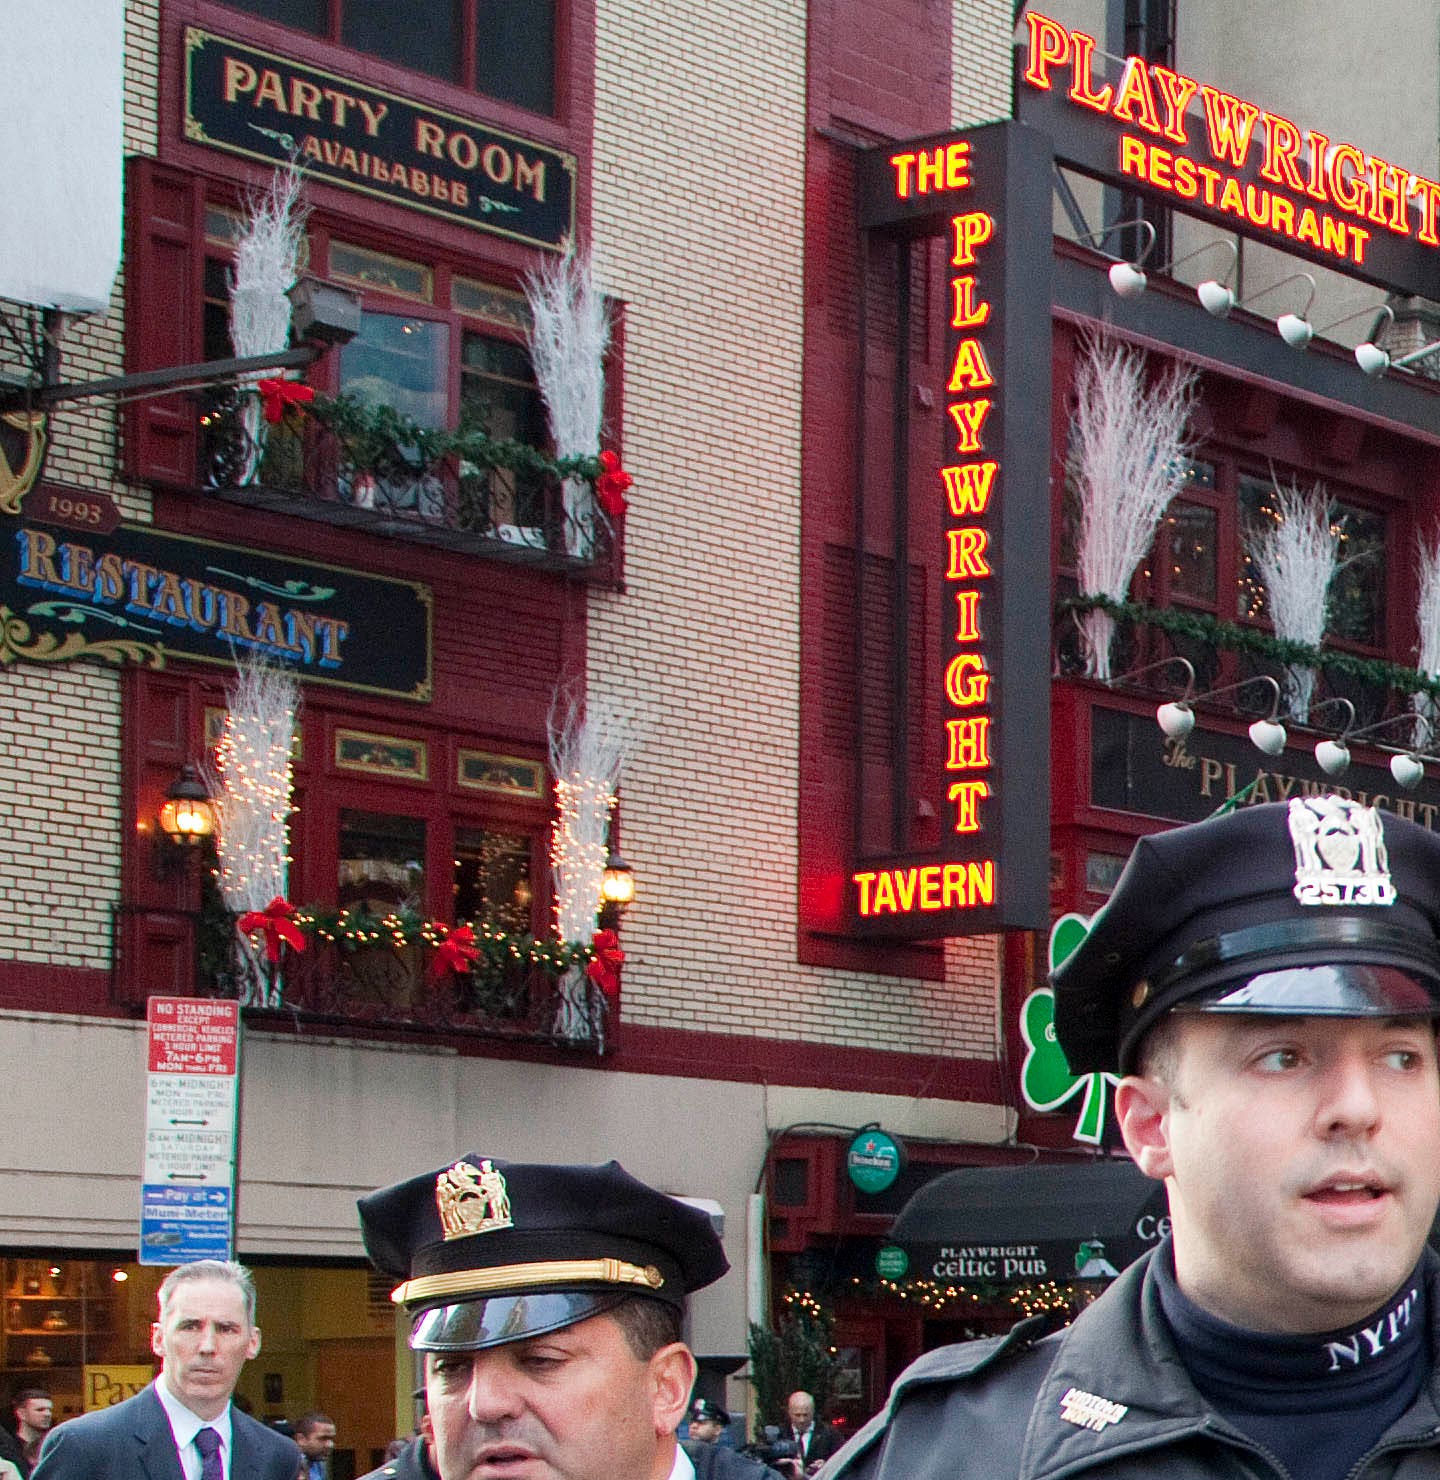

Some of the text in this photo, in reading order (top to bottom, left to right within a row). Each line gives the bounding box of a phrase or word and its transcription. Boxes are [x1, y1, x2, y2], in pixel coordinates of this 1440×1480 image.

[223, 57, 549, 203] PARTY ROOM
[891, 141, 972, 198] THE
[1120, 132, 1370, 265] RESTAURANT
[49, 496, 104, 525] 1993
[941, 210, 999, 834] PLAYWRIGHT
[15, 527, 351, 669] RESTAURANT
[854, 861, 995, 917] TAVERN
[156, 1003, 233, 1018] NO STANDING
[156, 1062, 183, 1071] MON
[143, 1206, 229, 1219] Muni-Meter
[165, 1188, 208, 1204] Pay at
[940, 1246, 1039, 1258] PLAYWRIGHT
